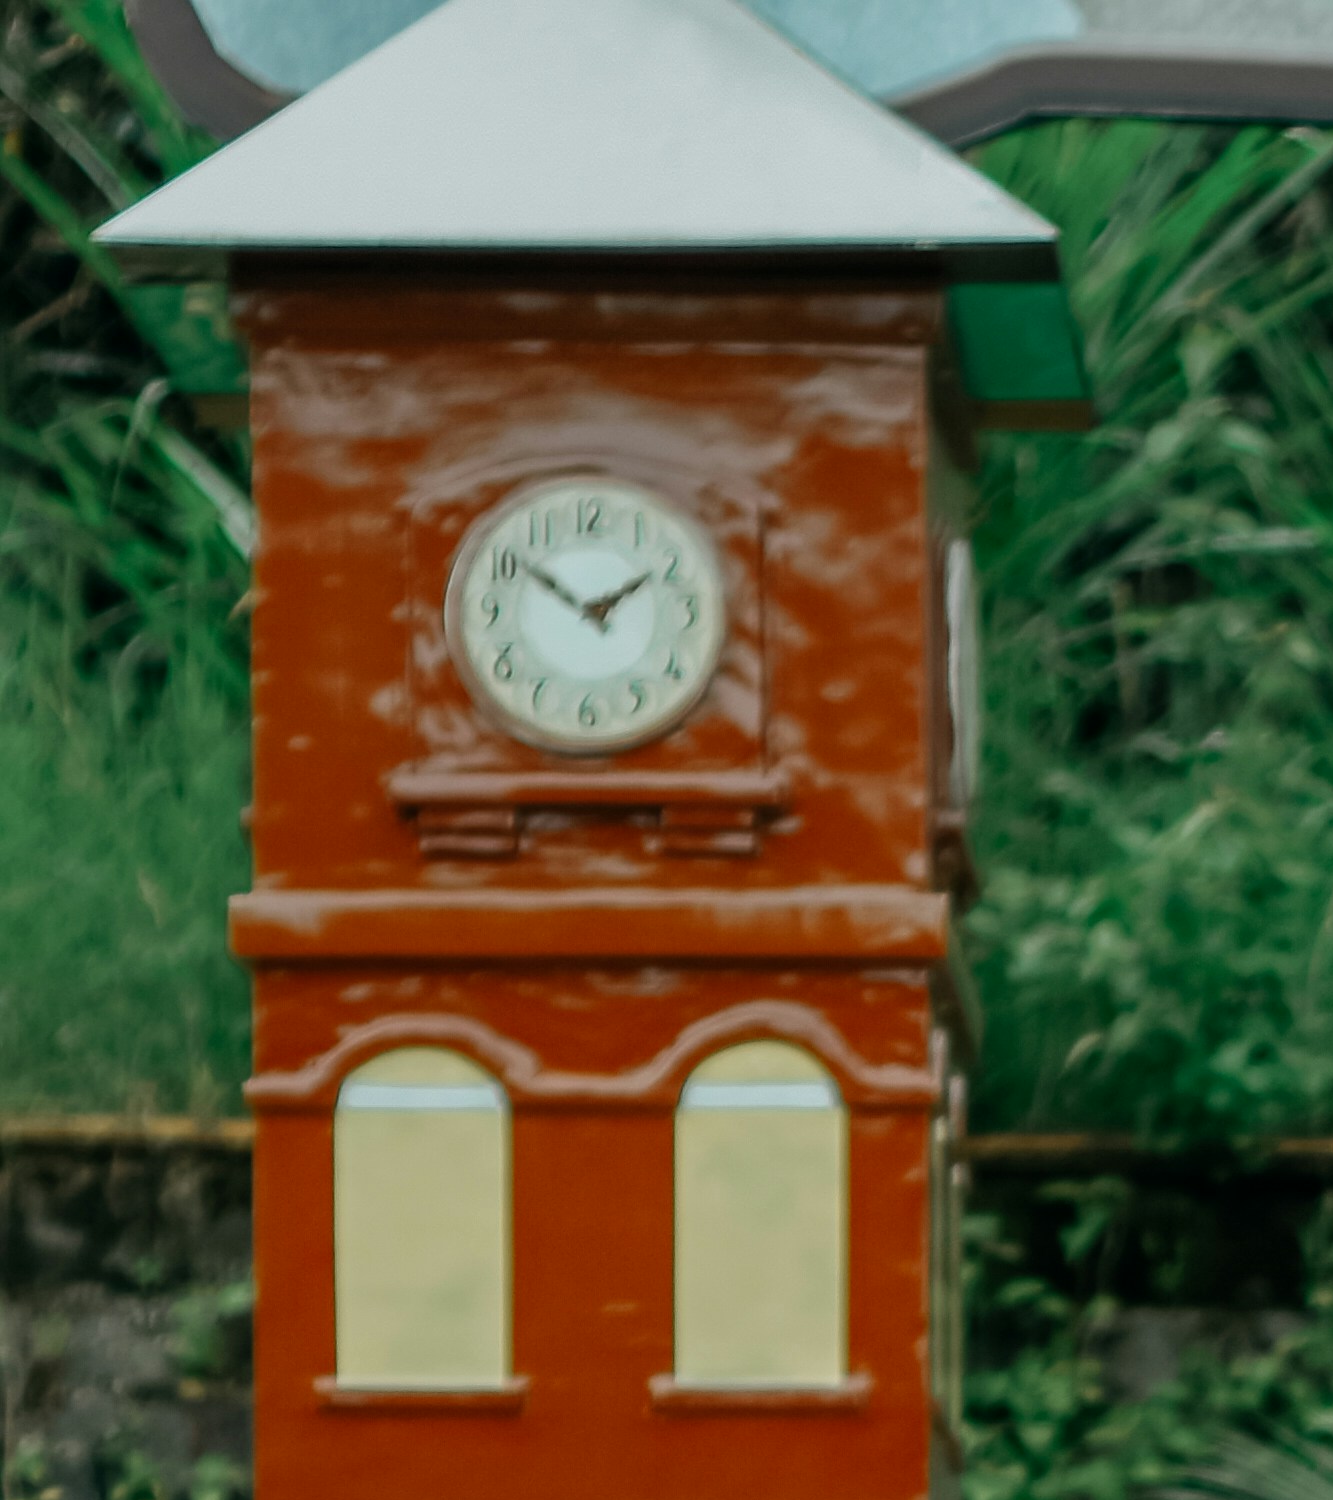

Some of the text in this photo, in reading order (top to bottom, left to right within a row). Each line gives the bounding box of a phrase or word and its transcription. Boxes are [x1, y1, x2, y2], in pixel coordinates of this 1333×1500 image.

[527, 509, 555, 548] 11
[575, 495, 606, 536] 12
[633, 510, 646, 551] 1
[491, 544, 517, 582] 10
[661, 547, 683, 585] 2
[480, 592, 500, 630] 9
[677, 594, 700, 632] 3
[661, 646, 686, 680] 4
[528, 677, 549, 712] 7
[577, 690, 597, 728] 6
[626, 677, 649, 715] 5
